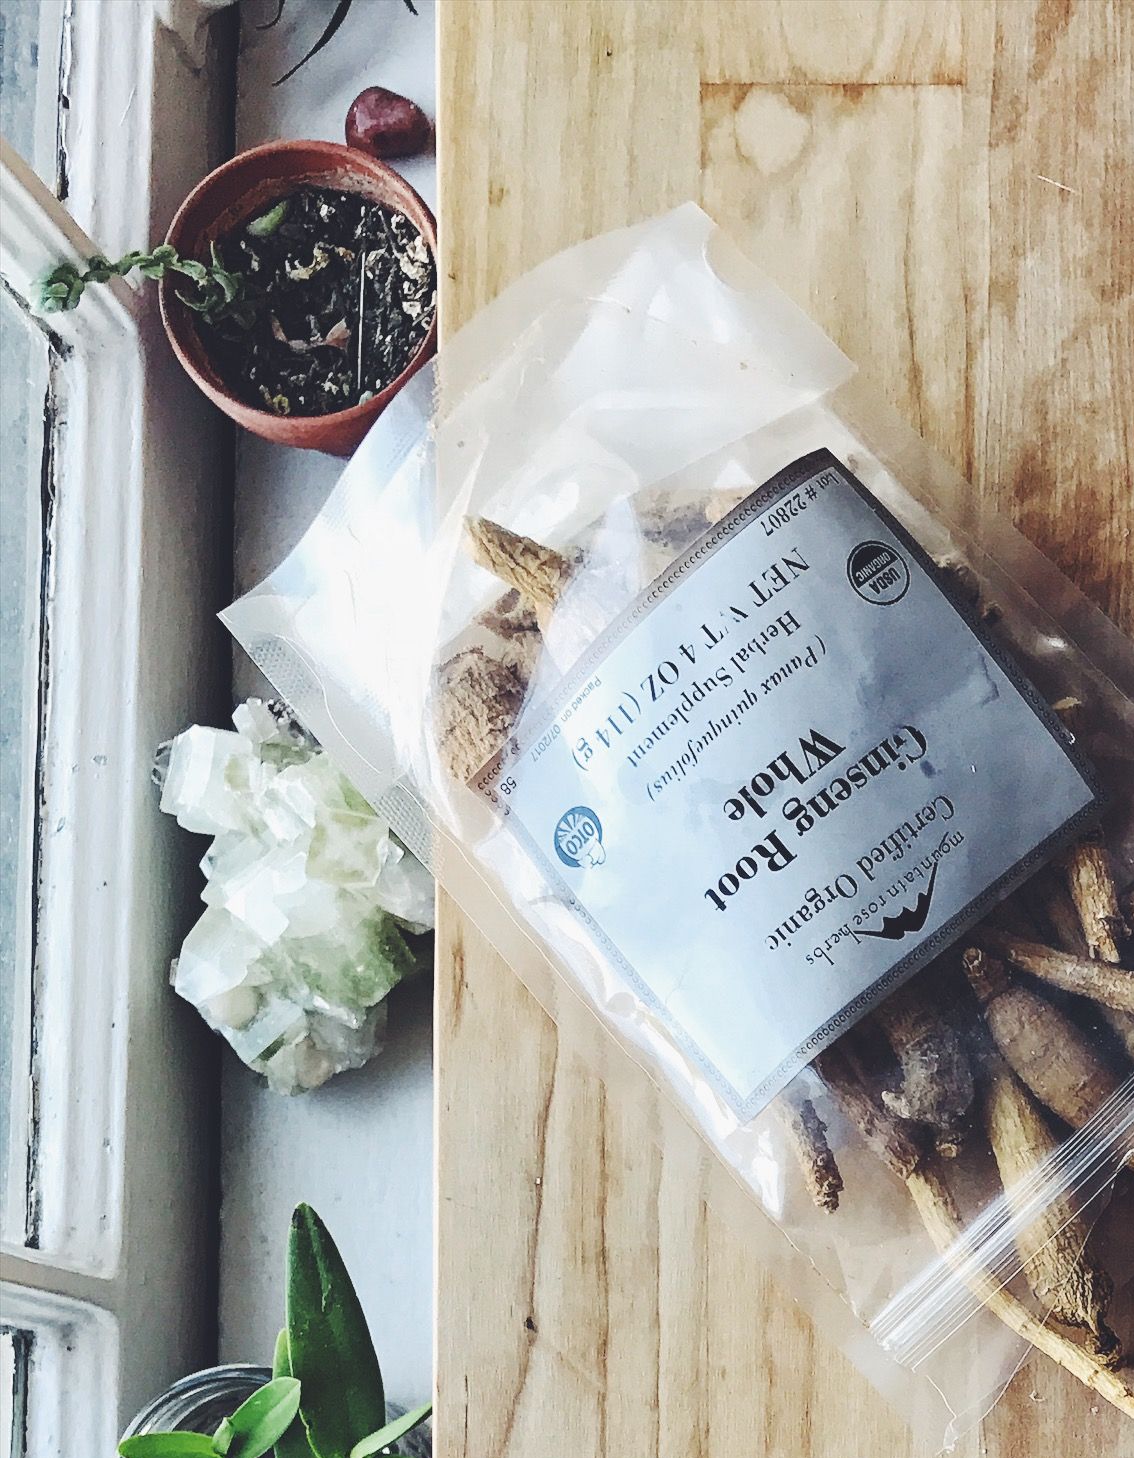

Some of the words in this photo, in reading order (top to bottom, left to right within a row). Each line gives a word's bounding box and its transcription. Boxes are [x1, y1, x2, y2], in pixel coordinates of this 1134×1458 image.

[805, 484, 818, 501] #
[815, 471, 841, 491] Lot
[760, 493, 808, 537] 22807
[747, 547, 811, 609] NET
[855, 552, 891, 583] ORGANIC
[868, 567, 902, 595] USDA
[678, 643, 697, 665] 4
[729, 610, 803, 675] Herbal
[570, 675, 603, 712] Packed
[639, 660, 681, 703] OZ
[560, 708, 573, 724] on
[594, 691, 642, 749] (114
[626, 666, 735, 769] Supplement
[530, 724, 561, 764] 07/2017
[571, 737, 595, 772] g)
[646, 688, 759, 803] quinquefolius)
[499, 776, 518, 796] 58
[722, 728, 847, 822] Whole
[782, 724, 927, 838] Ginseng
[565, 821, 596, 857] OTCO
[855, 795, 955, 882] Certified
[703, 829, 799, 913] Root
[886, 831, 965, 898] mountain
[766, 873, 859, 951] Organic
[852, 895, 887, 926] rose
[805, 923, 862, 967] herbs
